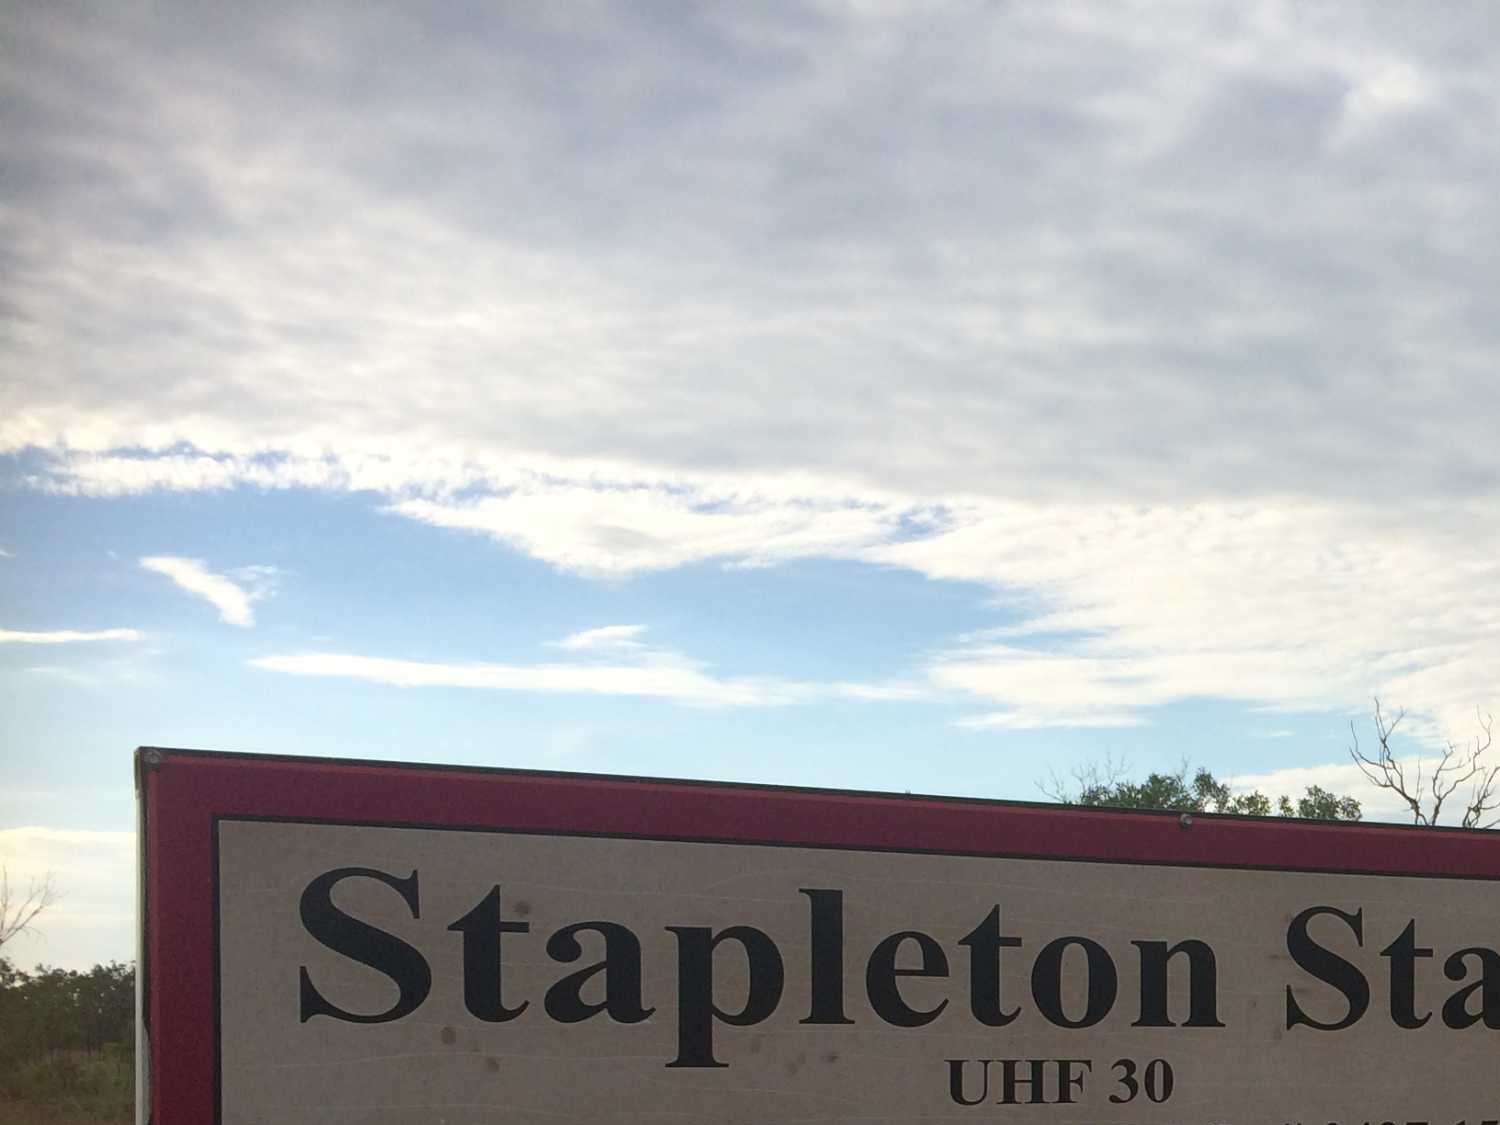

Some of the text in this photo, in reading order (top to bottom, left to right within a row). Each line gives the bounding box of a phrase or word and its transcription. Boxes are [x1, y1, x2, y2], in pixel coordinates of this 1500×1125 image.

[299, 866, 1225, 1068] Stapleton
[944, 1058, 1174, 1106] UHF 30
